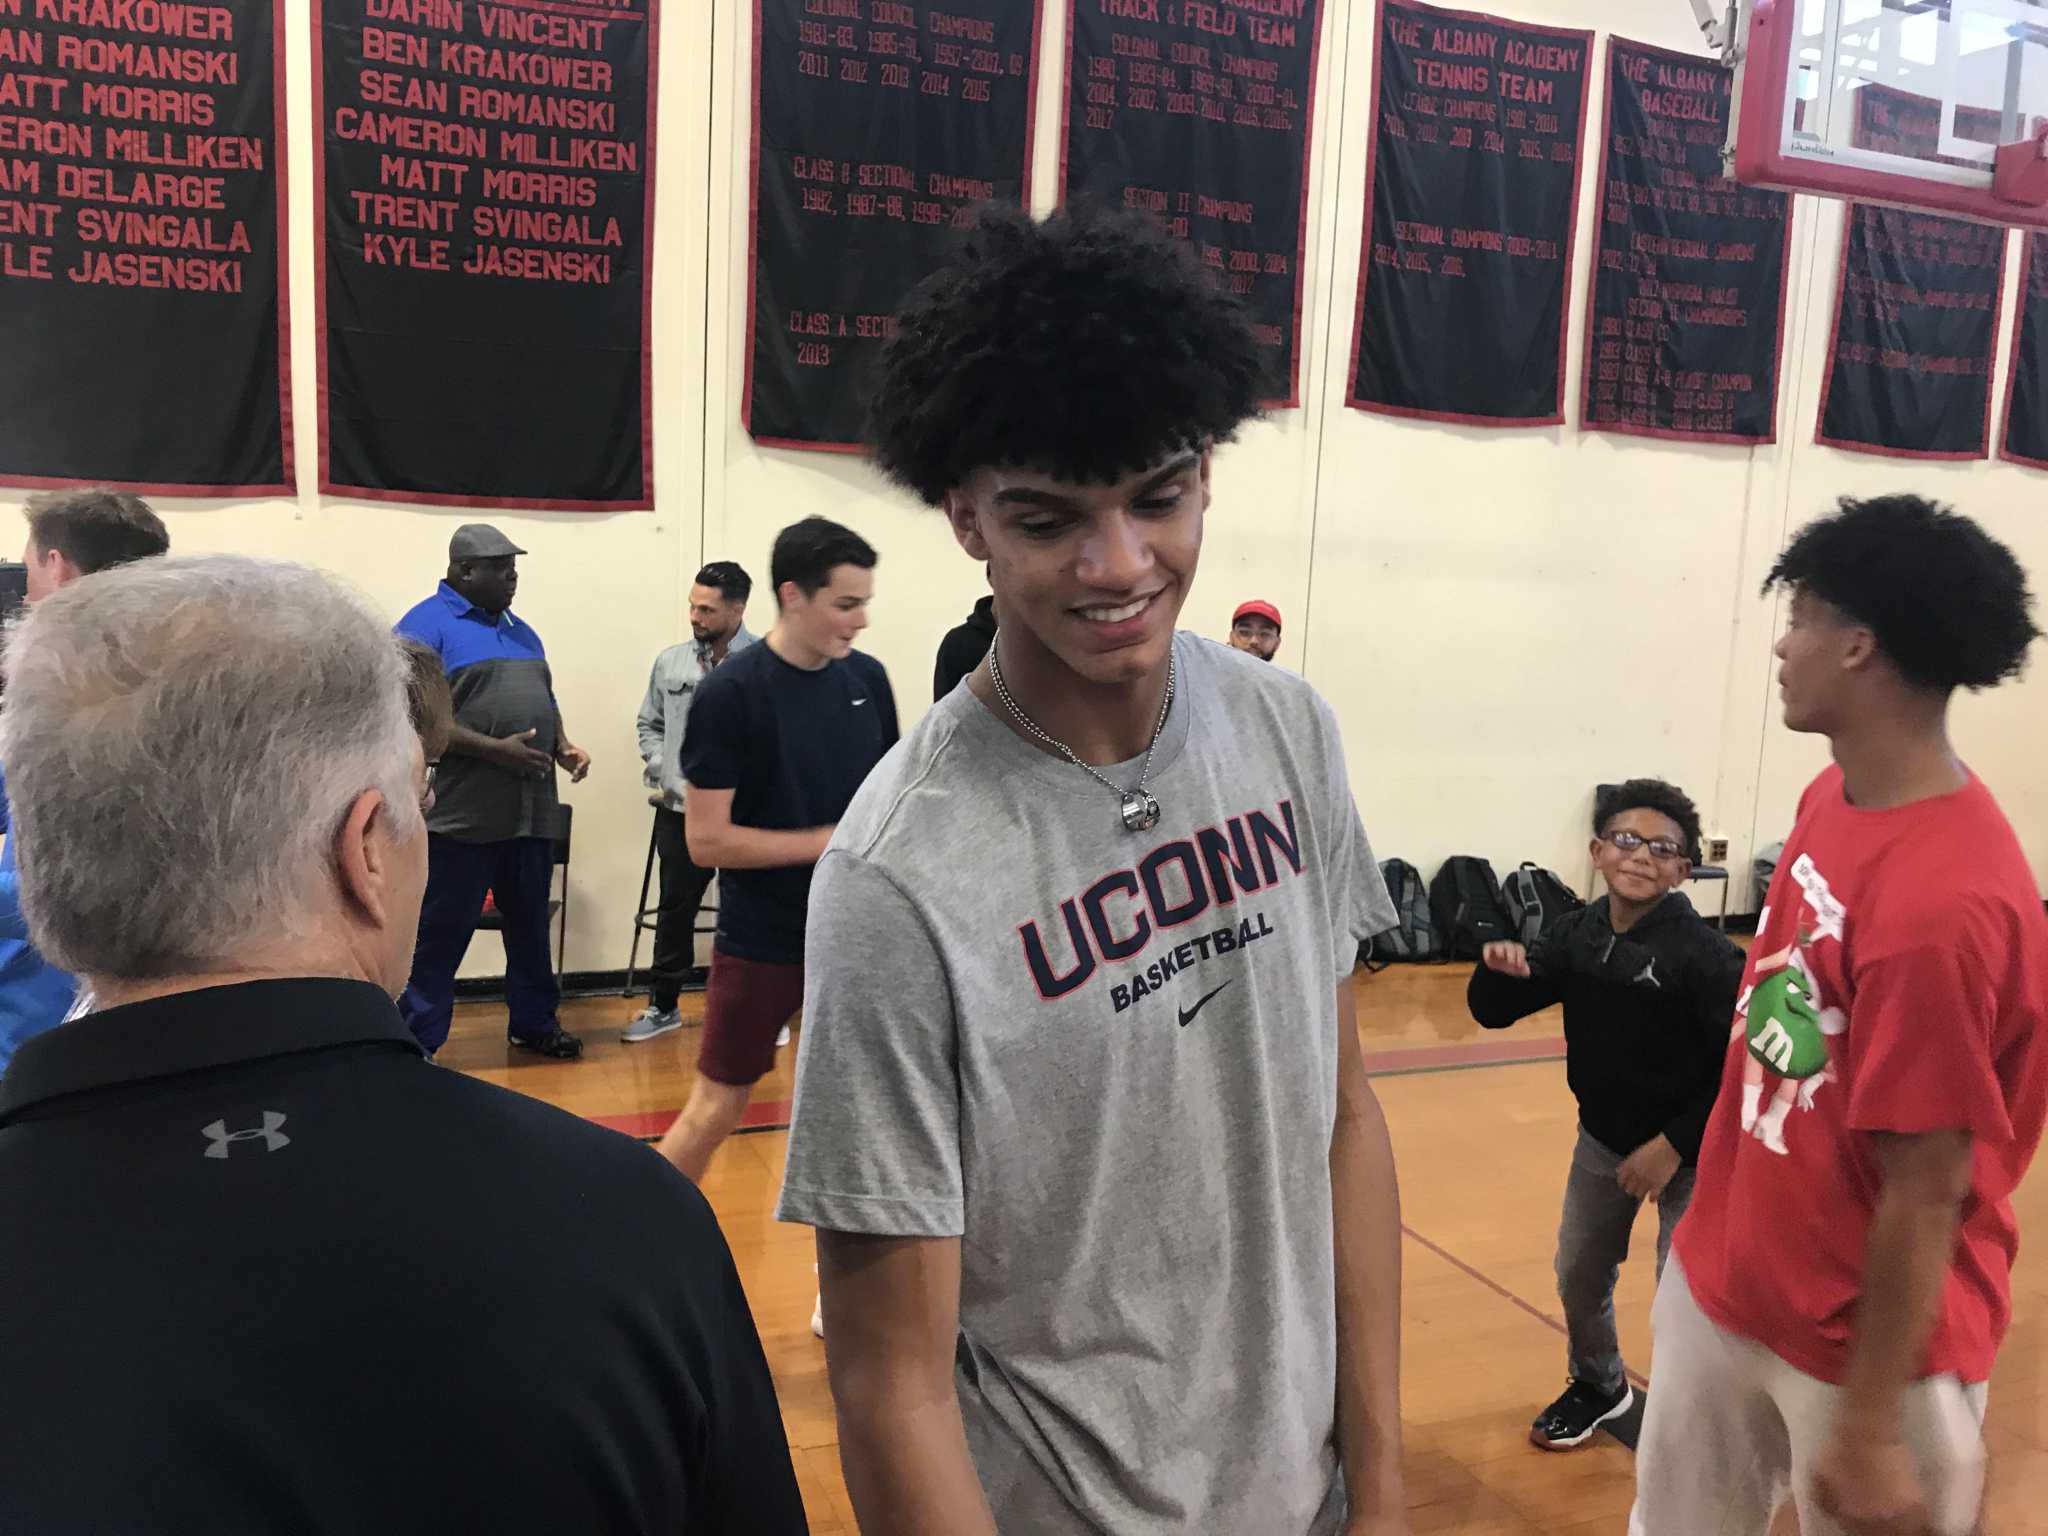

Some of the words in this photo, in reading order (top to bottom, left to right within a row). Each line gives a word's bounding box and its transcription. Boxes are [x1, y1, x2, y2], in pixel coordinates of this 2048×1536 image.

[35, 0, 233, 41] KRAKOWER
[366, 0, 463, 32] DARIN
[478, 4, 609, 51] VINCENT
[929, 11, 994, 43] CHAMPIONS
[1184, 2, 1236, 37] FIELD
[1248, 16, 1296, 48] TEAM
[1390, 16, 1424, 48] THE
[1432, 28, 1498, 58] ALBANY
[1504, 39, 1579, 73] ACADEMY
[0, 28, 42, 65] AN
[57, 35, 237, 84] ROMANSKI
[362, 26, 428, 68] BEN
[441, 39, 613, 93] KRAKOWER
[798, 50, 829, 78] 2011
[840, 57, 868, 83] 2012
[881, 63, 909, 88] 2013
[921, 71, 949, 96] 2014
[961, 77, 990, 101] 2015
[1222, 53, 1279, 82] CHAMPIONS
[1414, 58, 1488, 91] TENNIS
[1499, 72, 1553, 104] TEAM
[1620, 53, 1649, 83] THE
[1658, 64, 1717, 96] ALBANY
[0, 73, 68, 111] ATT
[82, 82, 215, 126] MORRIS
[359, 69, 447, 113] SEAN
[459, 85, 615, 132] ROMANSKI
[1444, 98, 1496, 122] CHAMPIONS
[1642, 89, 1720, 123] BASEBALL
[0, 115, 91, 157] ERON
[106, 128, 263, 170] MILLIKEN
[335, 107, 487, 159] CAMERON
[502, 132, 637, 172] MILLIKEN
[0, 158, 39, 194] AM
[57, 164, 225, 209] DELARGE
[380, 154, 469, 195] MATT
[483, 167, 598, 207] MORRIS
[793, 156, 834, 182] CLASS
[858, 164, 918, 192] SECTIONAL
[929, 173, 993, 200] CHAMPIONS
[0, 201, 62, 237] ENT
[77, 208, 251, 253] SVINGALA
[351, 190, 459, 233] TRENT
[473, 206, 622, 246] SVINGALA
[1199, 195, 1253, 223] CHAMPIONS
[364, 233, 450, 271] KYLE
[463, 244, 610, 284] JASENSKI
[1451, 228, 1504, 251] CHAMPIONS
[0, 242, 53, 280] LE
[68, 250, 241, 293] JASENSKI
[790, 310, 830, 335] CLASS
[838, 314, 847, 336] A
[798, 342, 831, 366] 2013
[1016, 799, 1306, 1000] UCONN
[1110, 913, 1274, 1013] BASKETBALL
[1750, 1017, 1794, 1073] m
